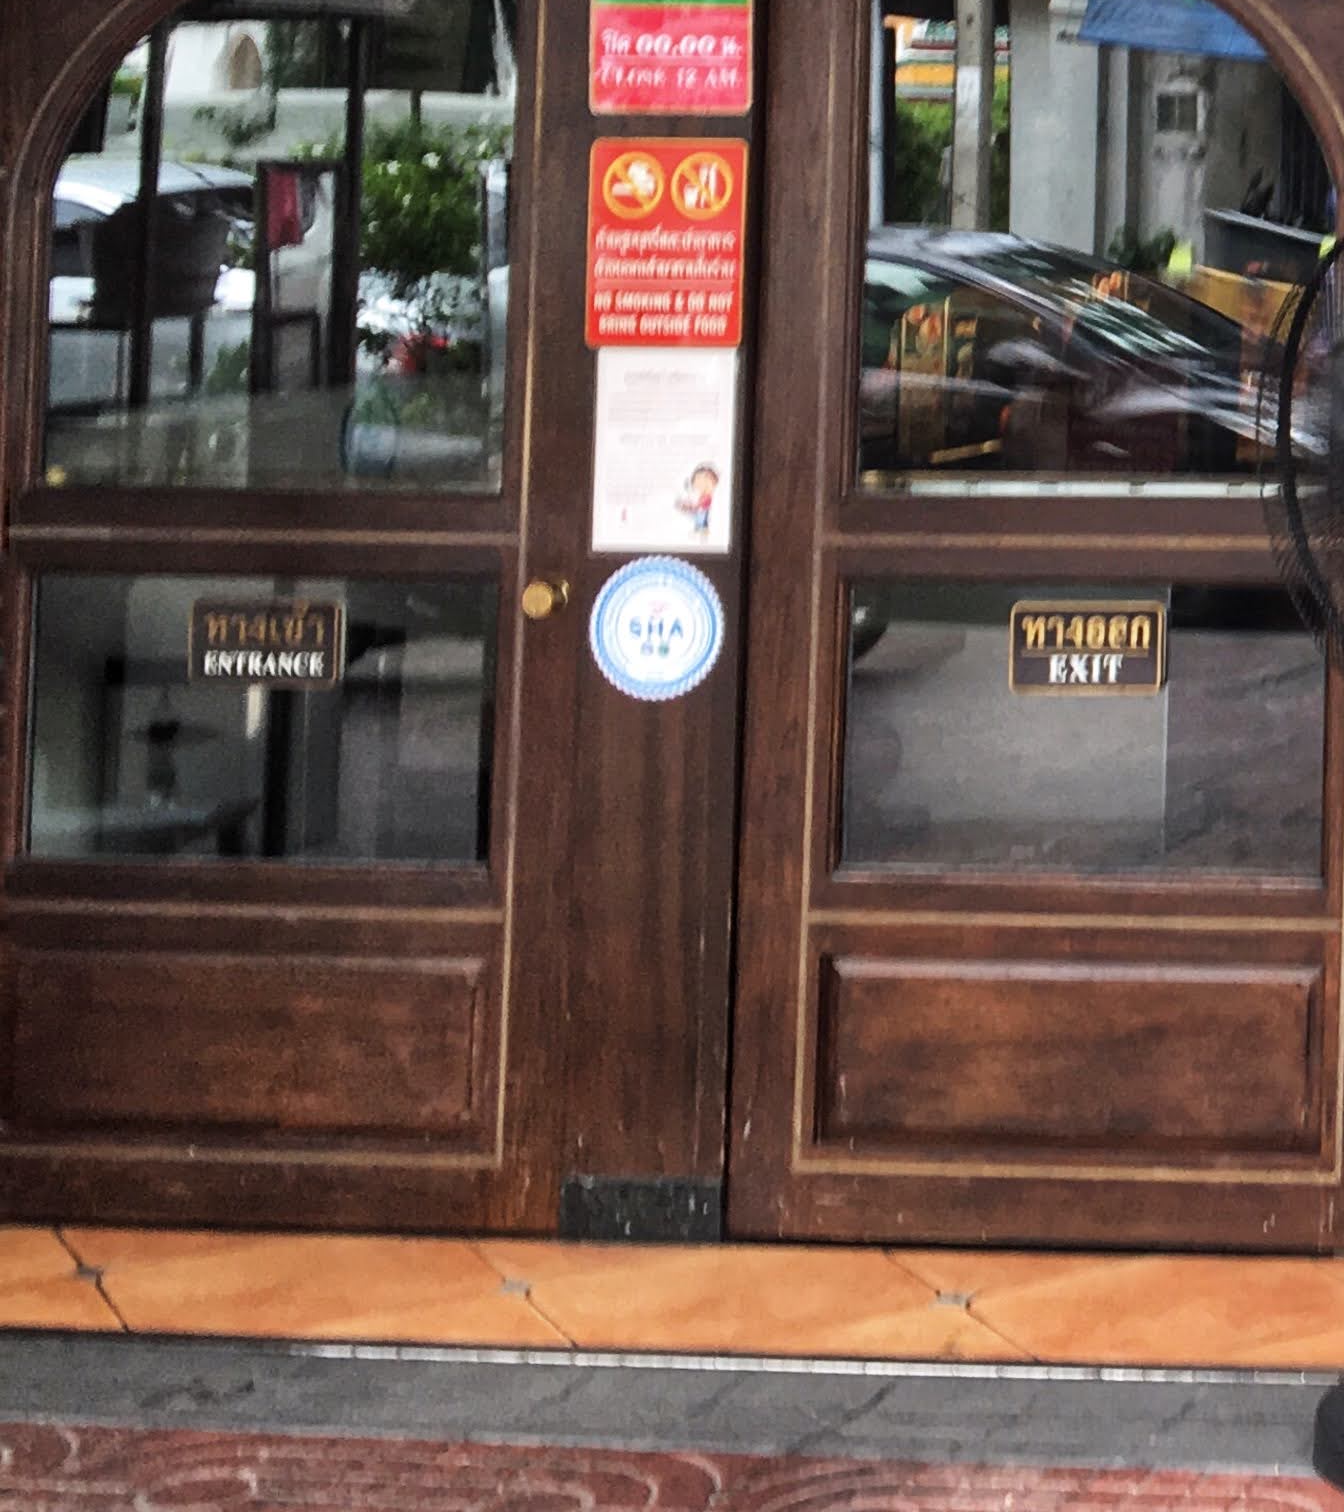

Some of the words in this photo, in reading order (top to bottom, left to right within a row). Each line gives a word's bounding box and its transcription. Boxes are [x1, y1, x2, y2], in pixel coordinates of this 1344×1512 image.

[1021, 614, 1152, 651] ทางออก
[203, 650, 326, 679] ENTRANCE
[1048, 653, 1125, 684] EXIT
